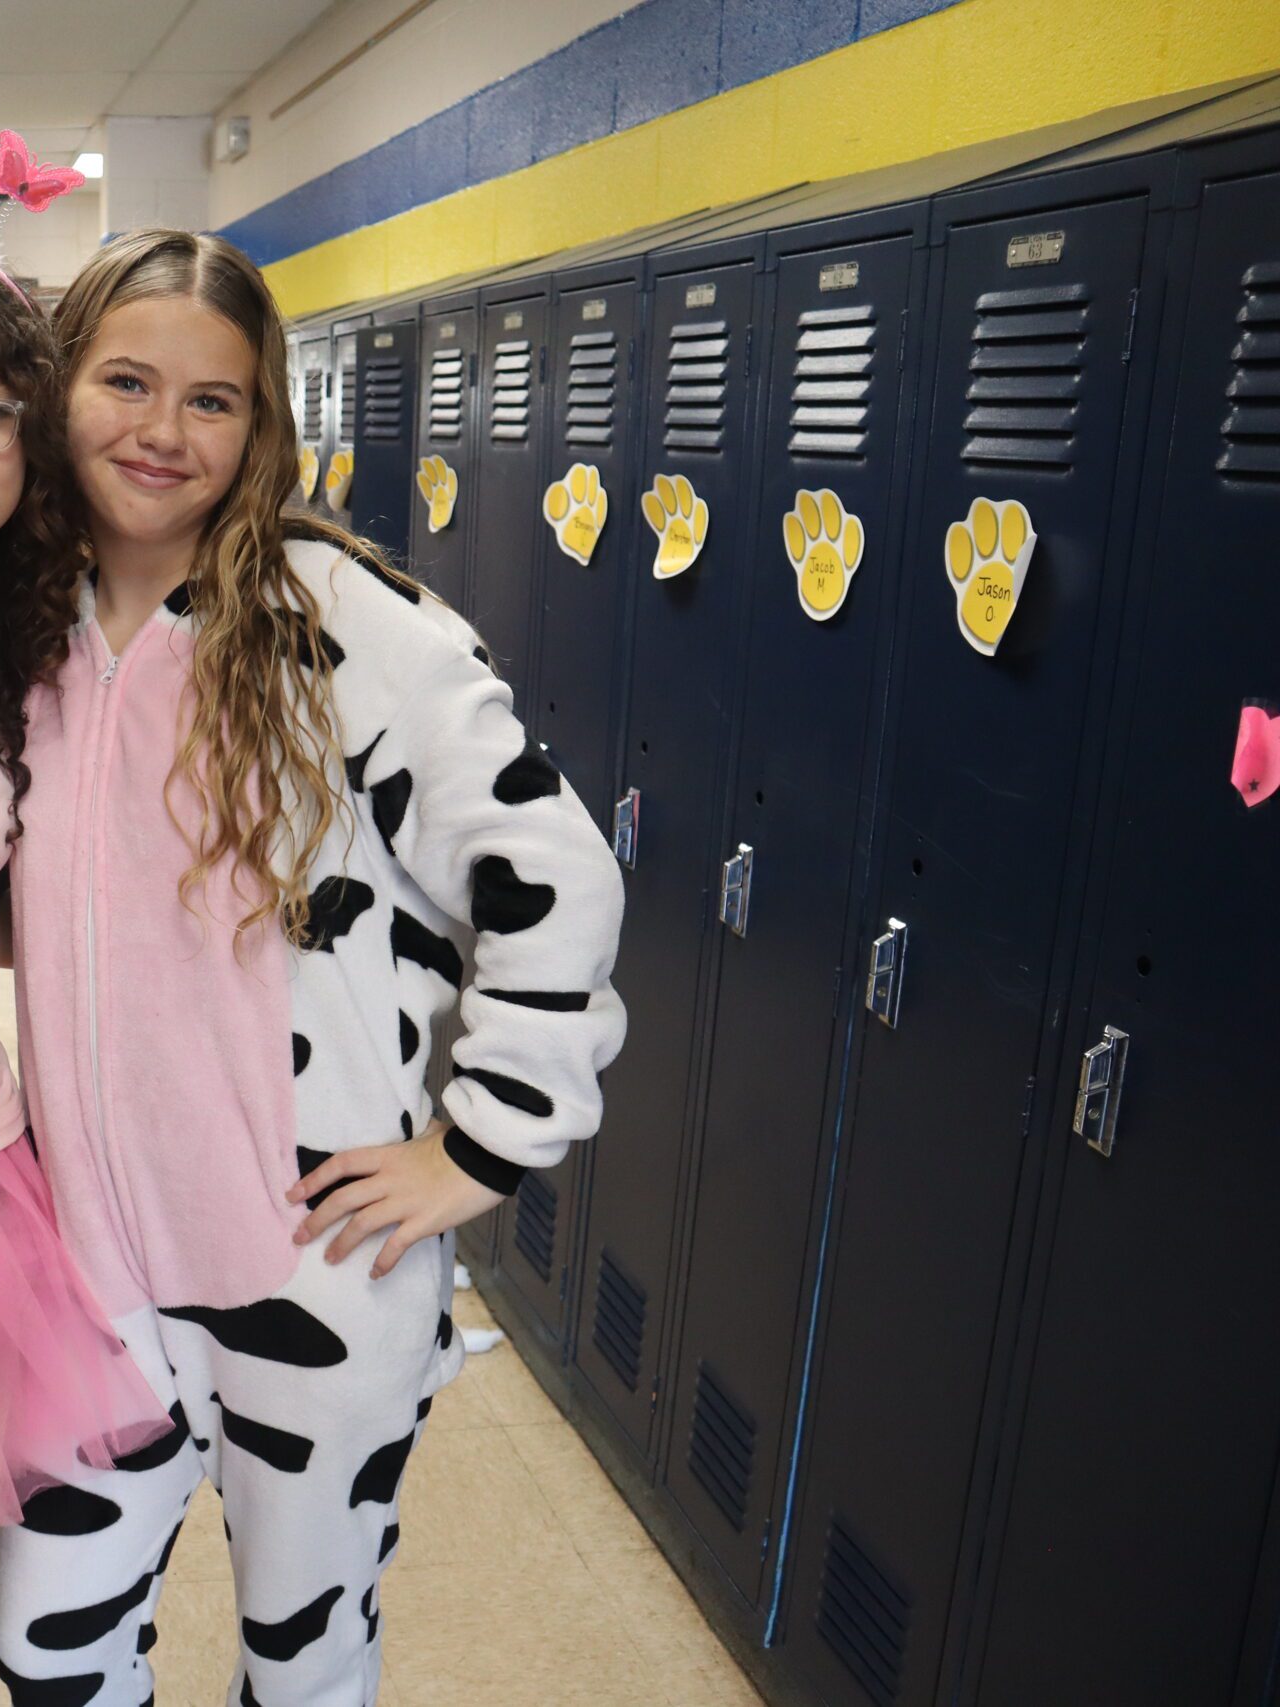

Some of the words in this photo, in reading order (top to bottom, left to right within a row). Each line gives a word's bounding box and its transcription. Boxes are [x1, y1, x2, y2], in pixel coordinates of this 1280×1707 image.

[1029, 241, 1042, 259] 63
[809, 556, 835, 574] Jacob
[817, 577, 825, 594] M
[977, 576, 1011, 601] Jason
